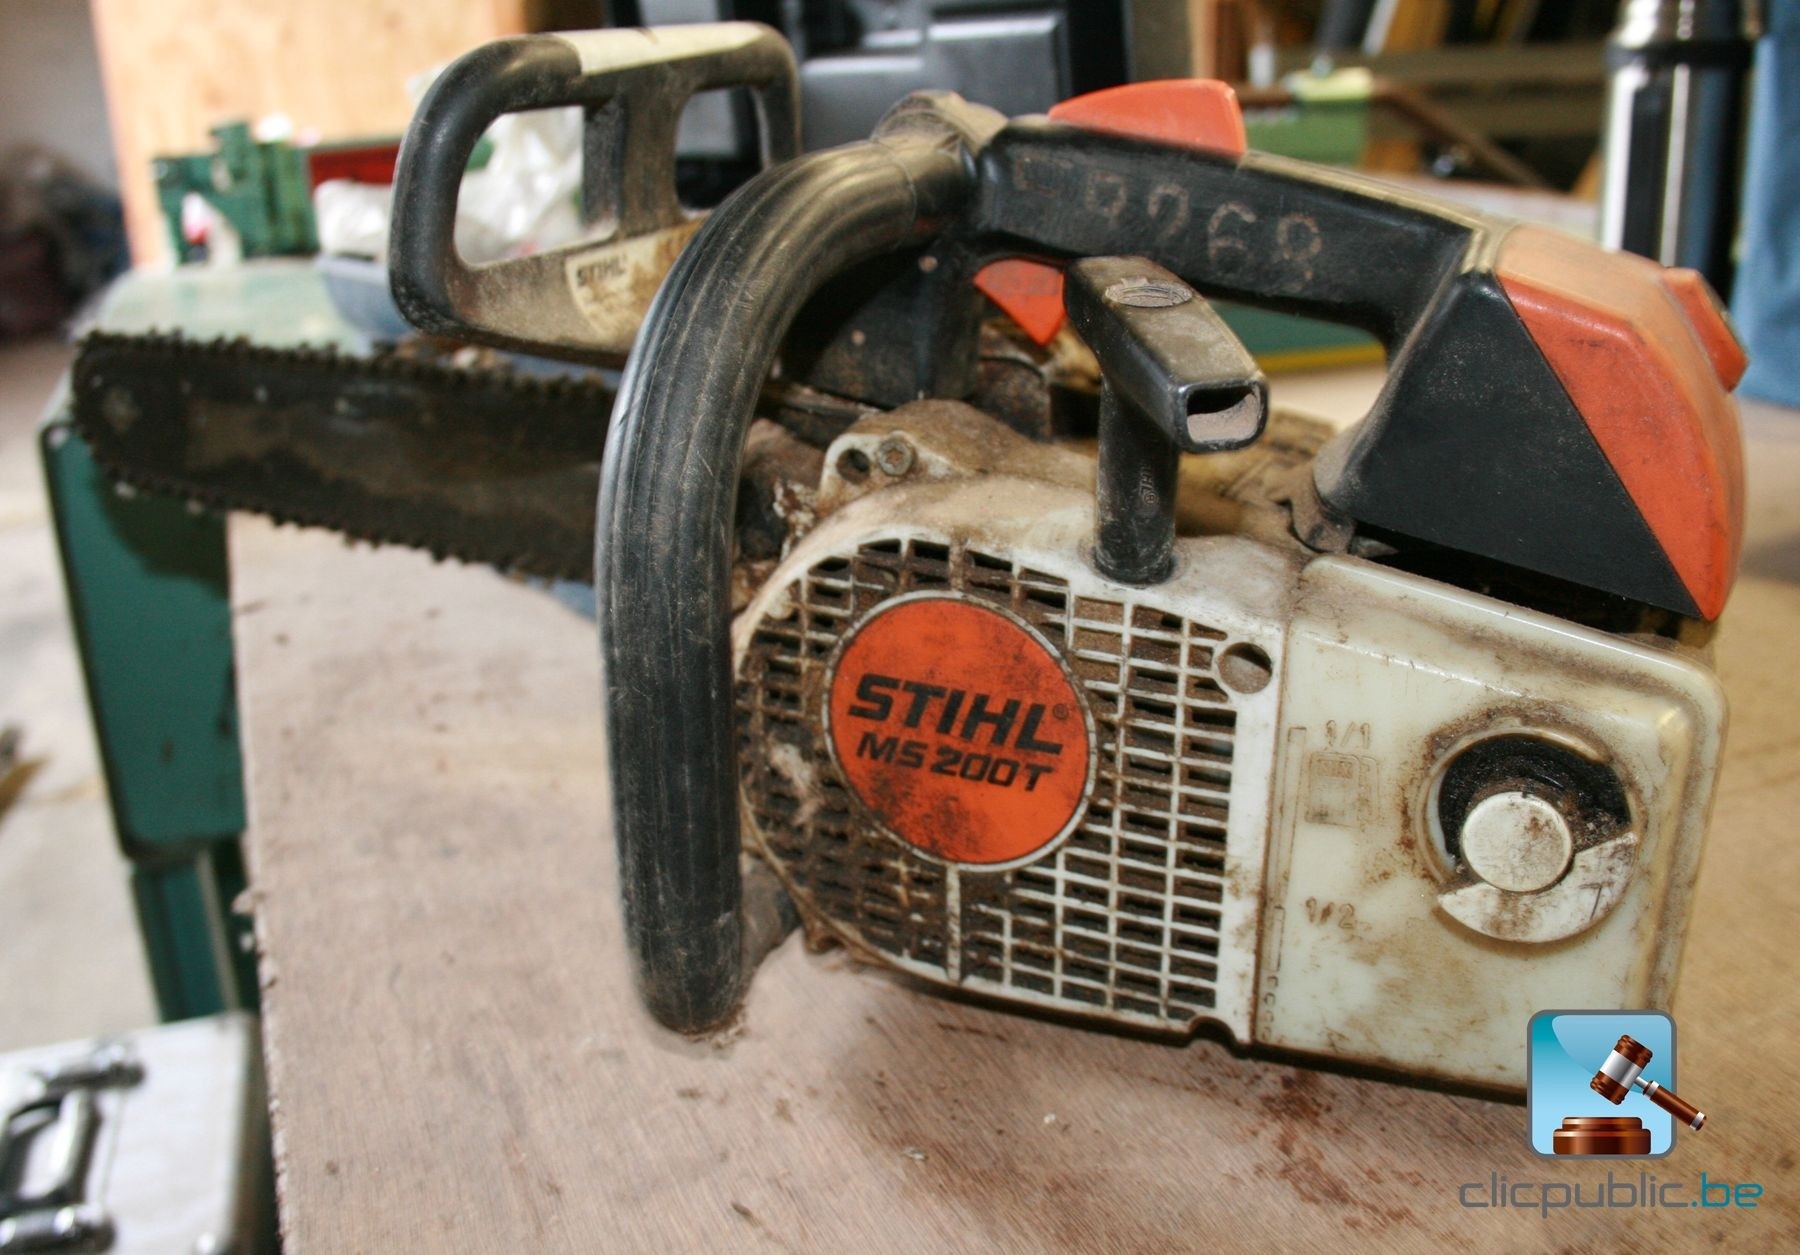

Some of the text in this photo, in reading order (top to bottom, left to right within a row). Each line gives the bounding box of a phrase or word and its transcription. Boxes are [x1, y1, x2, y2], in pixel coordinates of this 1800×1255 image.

[849, 673, 1064, 755] STIHL
[857, 731, 1054, 792] MS 200T
